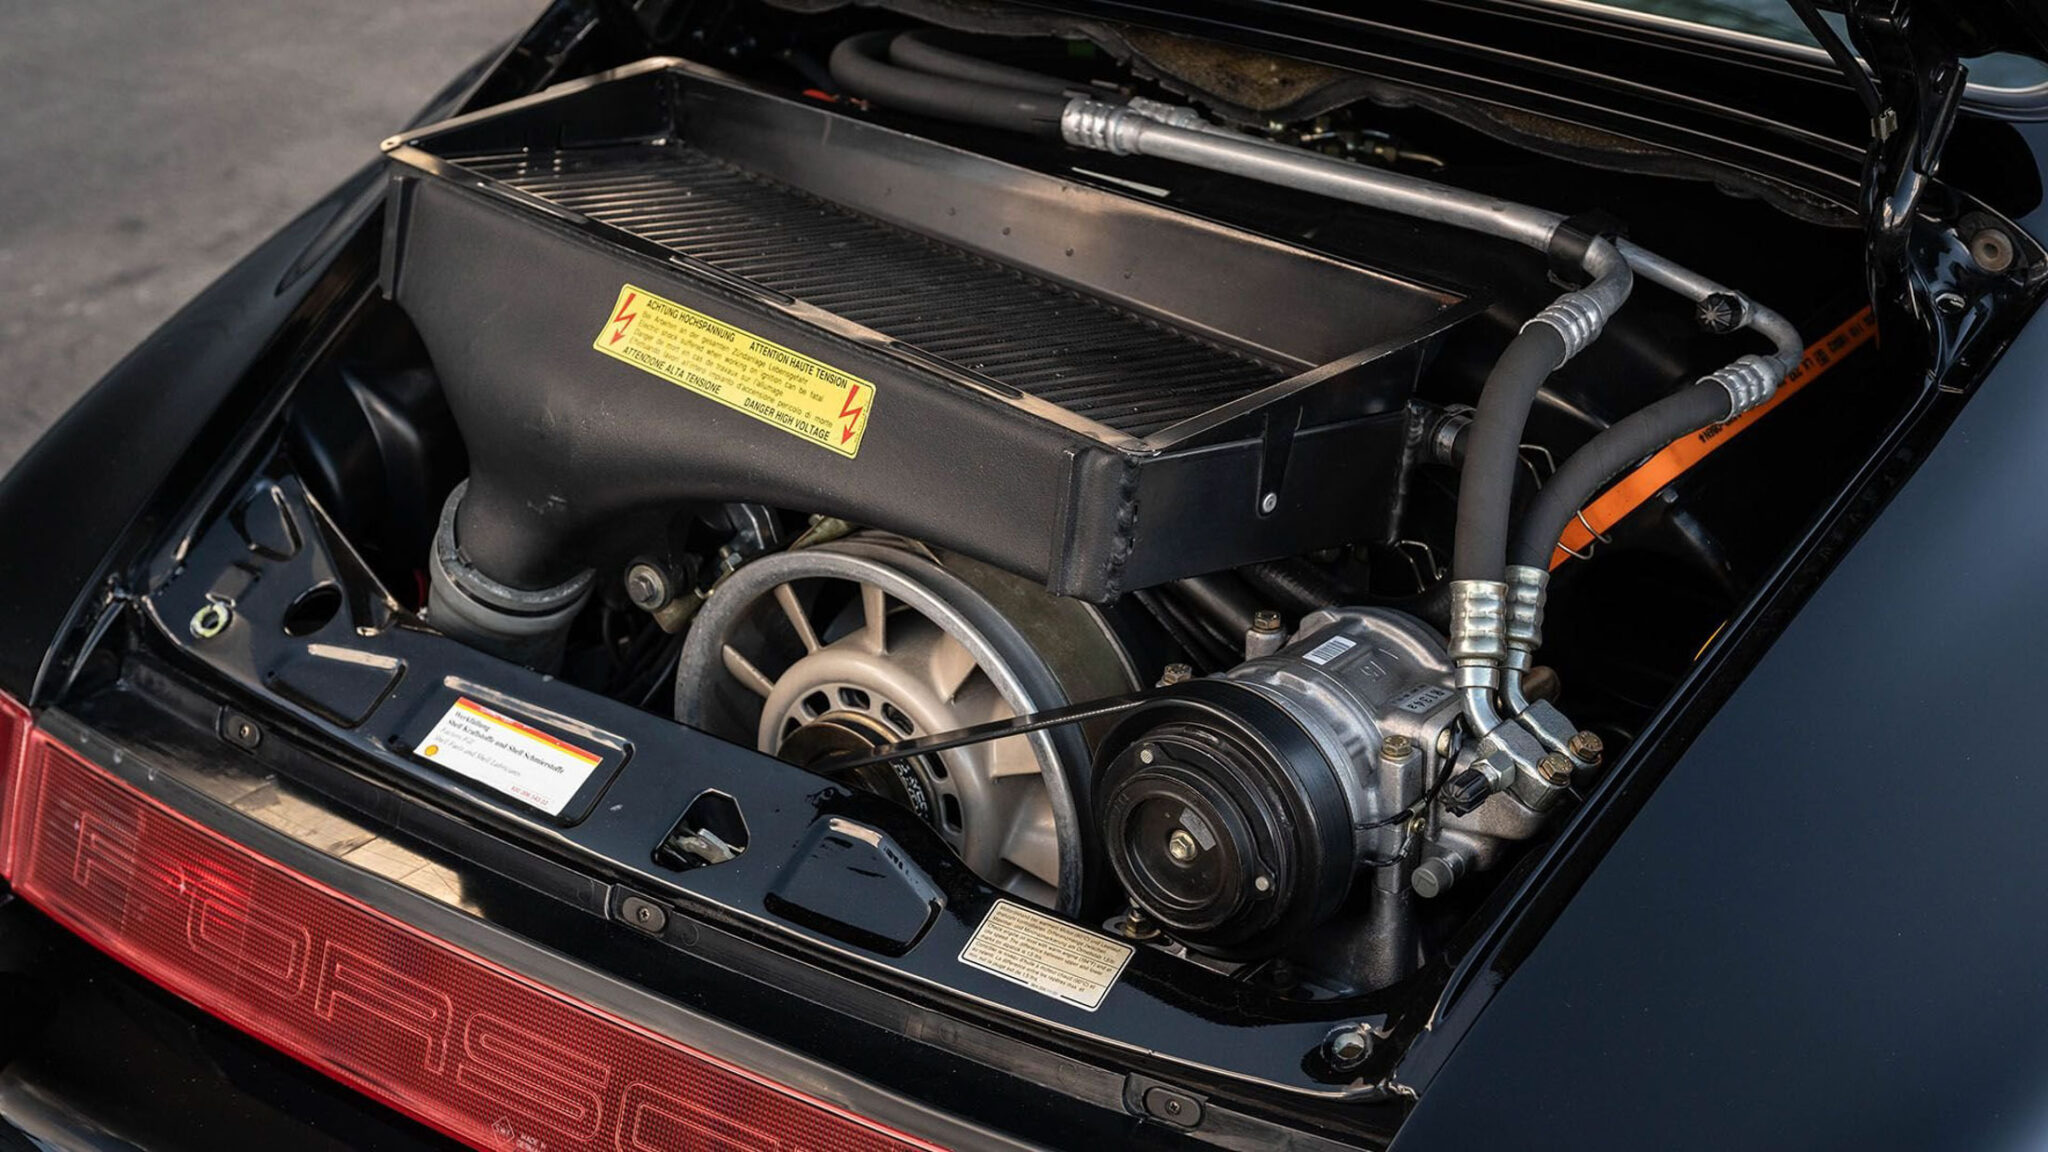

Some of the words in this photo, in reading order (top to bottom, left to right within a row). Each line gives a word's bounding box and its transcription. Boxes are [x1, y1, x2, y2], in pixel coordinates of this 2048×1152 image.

[647, 299, 679, 318] ACHTUNG
[679, 312, 735, 342] HOCHSPANNUNG
[623, 346, 665, 370] ATTENZIONE
[665, 364, 685, 378] ALTA
[685, 372, 721, 394] TENSIONE
[661, 329, 678, 340] shock
[707, 348, 722, 359] when
[724, 356, 747, 371] working
[750, 366, 757, 374] on
[760, 371, 782, 386] ignition
[785, 382, 796, 391] can
[799, 386, 806, 395] be
[810, 391, 823, 402] fatal
[750, 341, 789, 364] ATTENTION
[789, 357, 814, 375] HAUTE
[816, 368, 847, 389] TENSION
[744, 397, 775, 417] DANGER
[775, 410, 794, 425] HIGH
[795, 418, 830, 441] VOLTAGE
[73, 813, 900, 1152] PORSC
